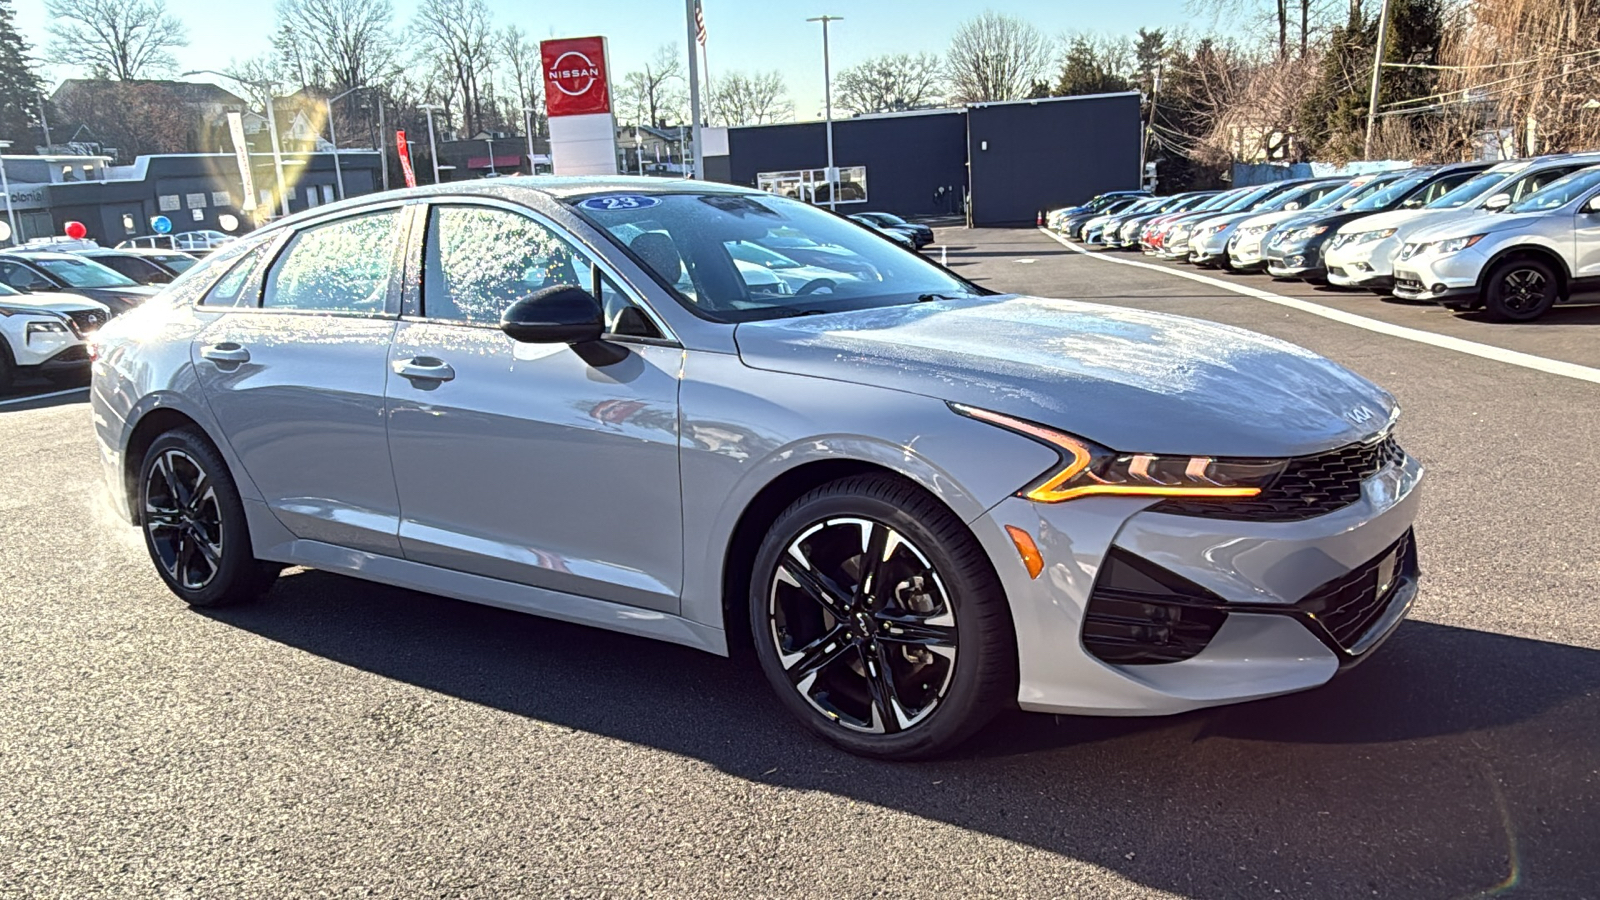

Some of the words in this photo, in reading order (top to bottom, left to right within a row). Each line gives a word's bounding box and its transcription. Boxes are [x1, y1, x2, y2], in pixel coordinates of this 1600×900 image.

[549, 68, 598, 79] NISSAN
[5, 188, 44, 203] olonial
[603, 198, 639, 209] 23
